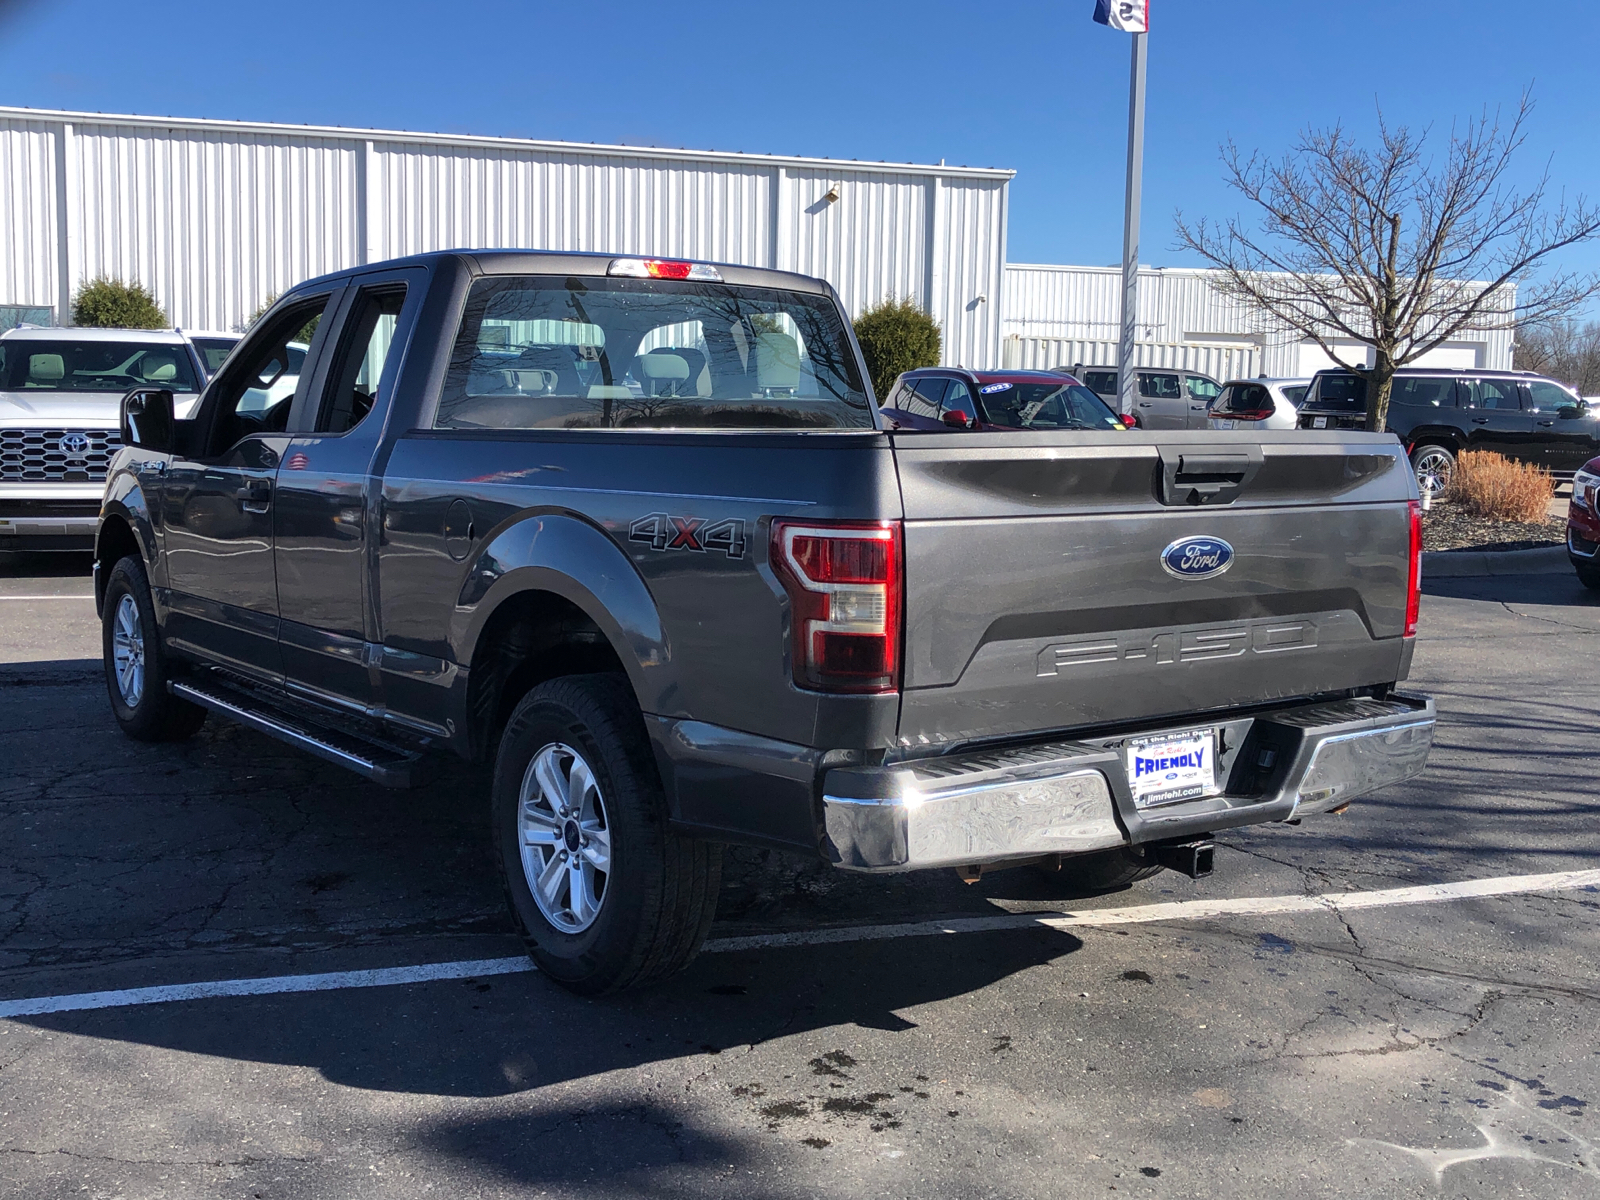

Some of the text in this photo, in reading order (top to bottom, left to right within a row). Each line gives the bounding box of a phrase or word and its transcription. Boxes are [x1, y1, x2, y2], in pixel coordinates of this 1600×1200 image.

[1181, 544, 1220, 569] Ford
[1037, 620, 1318, 677] F-150
[1193, 728, 1212, 736] Deal
[1135, 746, 1204, 778] FRIENDLY
[1147, 786, 1202, 805] jimriehl.com
